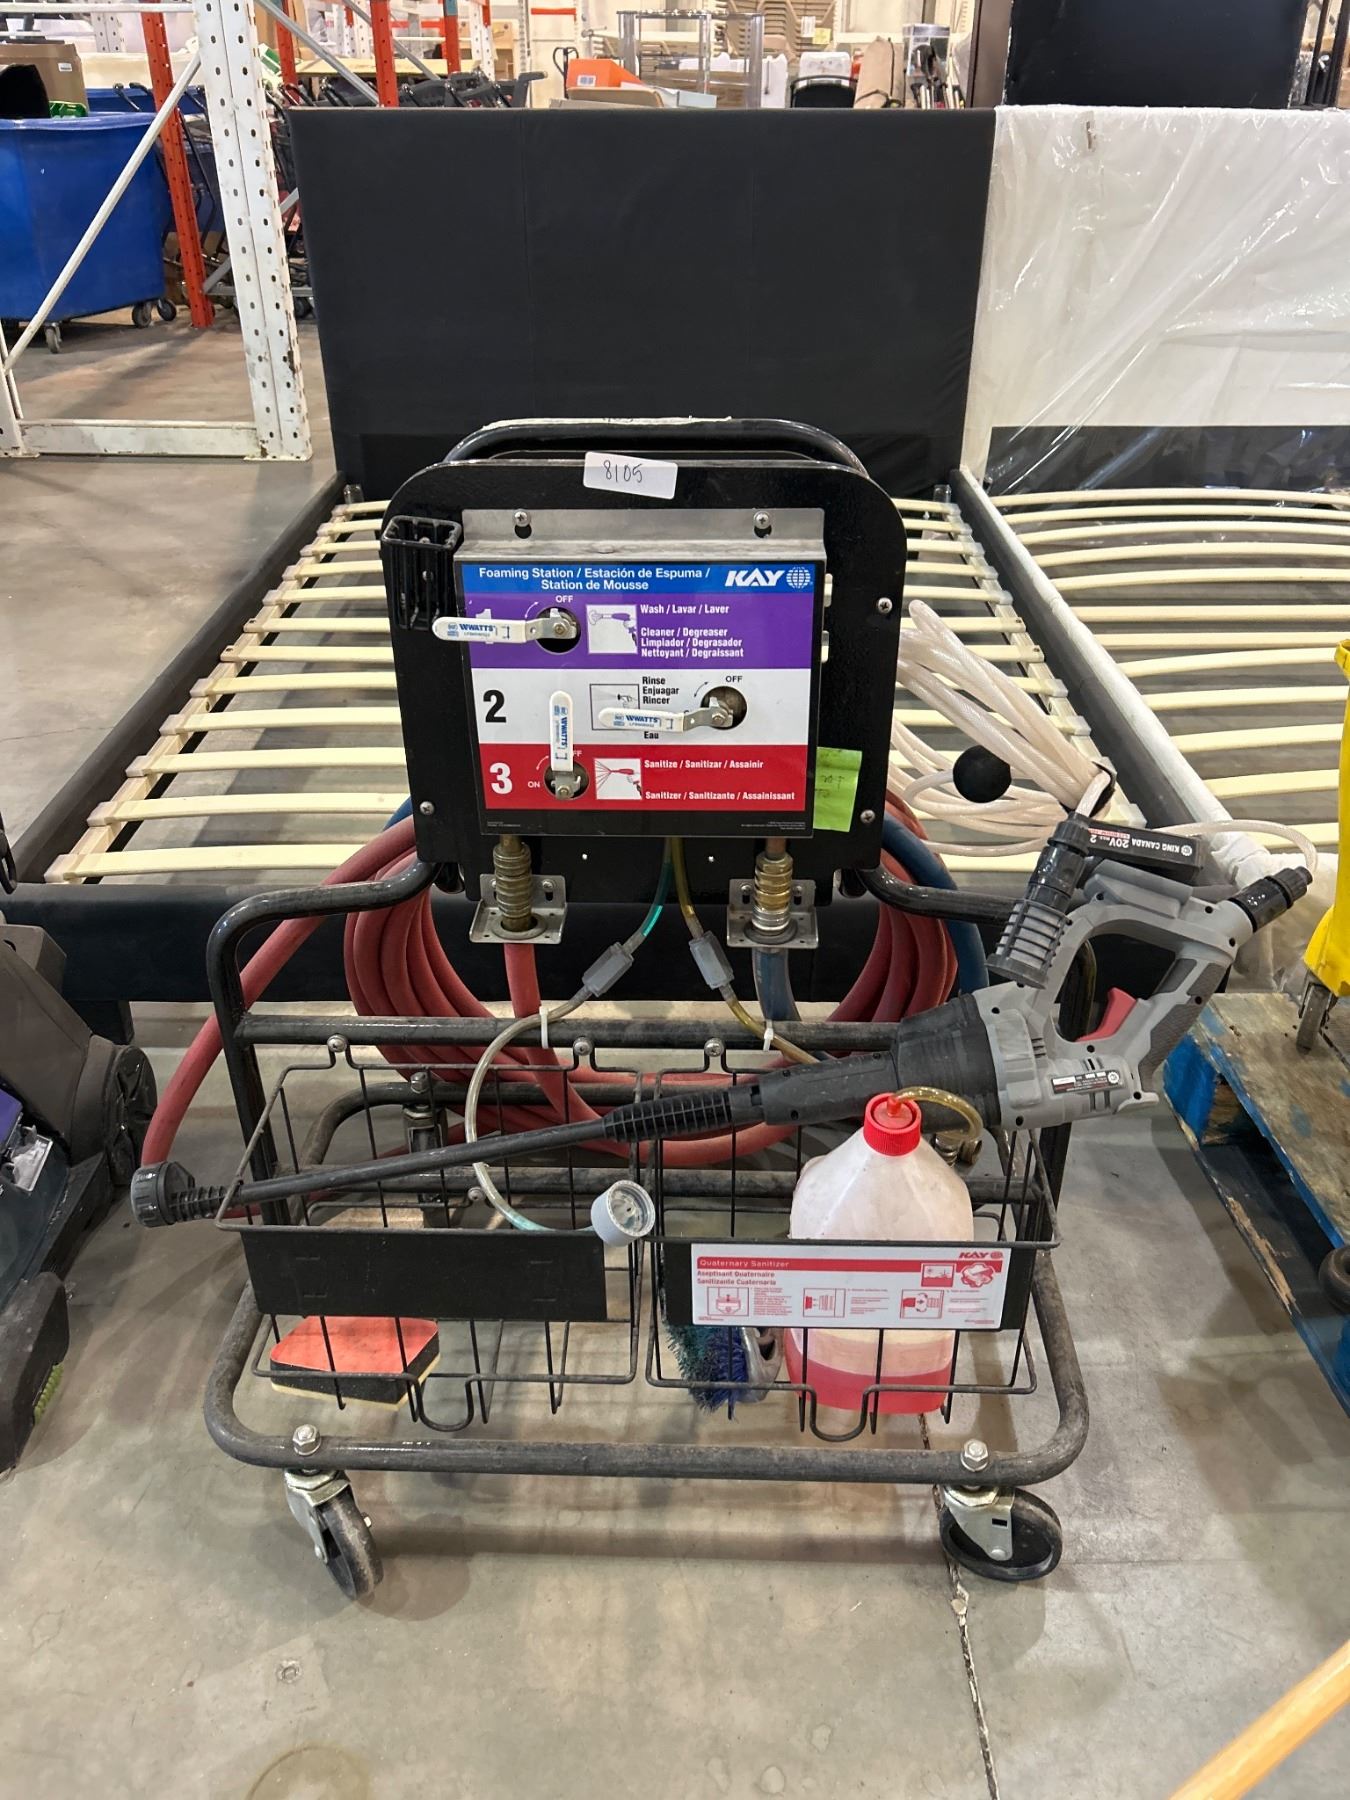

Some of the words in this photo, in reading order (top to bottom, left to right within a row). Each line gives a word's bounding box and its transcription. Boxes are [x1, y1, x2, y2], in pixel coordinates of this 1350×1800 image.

[603, 459, 643, 483] 8105
[479, 567, 529, 580] Foaming
[532, 567, 574, 578] Station
[584, 567, 635, 578] Estación
[637, 567, 652, 578] de
[655, 567, 702, 580] Espuma
[725, 568, 785, 587] KAY
[541, 579, 583, 590] Station
[585, 579, 600, 590] de
[603, 580, 649, 590] Mousse
[555, 595, 573, 603] OFF
[640, 604, 664, 614] Wash
[672, 604, 696, 614] Lavar
[704, 604, 729, 614] Laver
[640, 627, 674, 637] Cleaner
[682, 627, 728, 639] Degreaser
[641, 637, 684, 649] Limpiador
[692, 637, 742, 649] Degrasador
[641, 648, 684, 660] Nettoyant
[691, 648, 744, 660] Degraissant
[642, 676, 666, 685] Rinse
[642, 686, 679, 697] Enjuagar
[642, 696, 670, 705] Rincer
[483, 690, 507, 723] 2
[643, 731, 659, 739] Eau
[644, 759, 678, 768] Sanitize
[685, 759, 722, 768] Sanitizar
[729, 759, 764, 768] Assainir
[489, 762, 513, 795] 3
[527, 780, 541, 788] ON
[645, 791, 682, 800] Sanitizer
[688, 791, 735, 800] Sanitizante
[742, 791, 795, 800] Assainissant
[1109, 838, 1130, 848] 20V
[1132, 838, 1160, 850] CANADA
[1162, 843, 1180, 853] KING
[959, 1251, 989, 1259] KAY
[700, 1259, 748, 1267] Quaternary
[751, 1260, 790, 1268] Sanitizer
